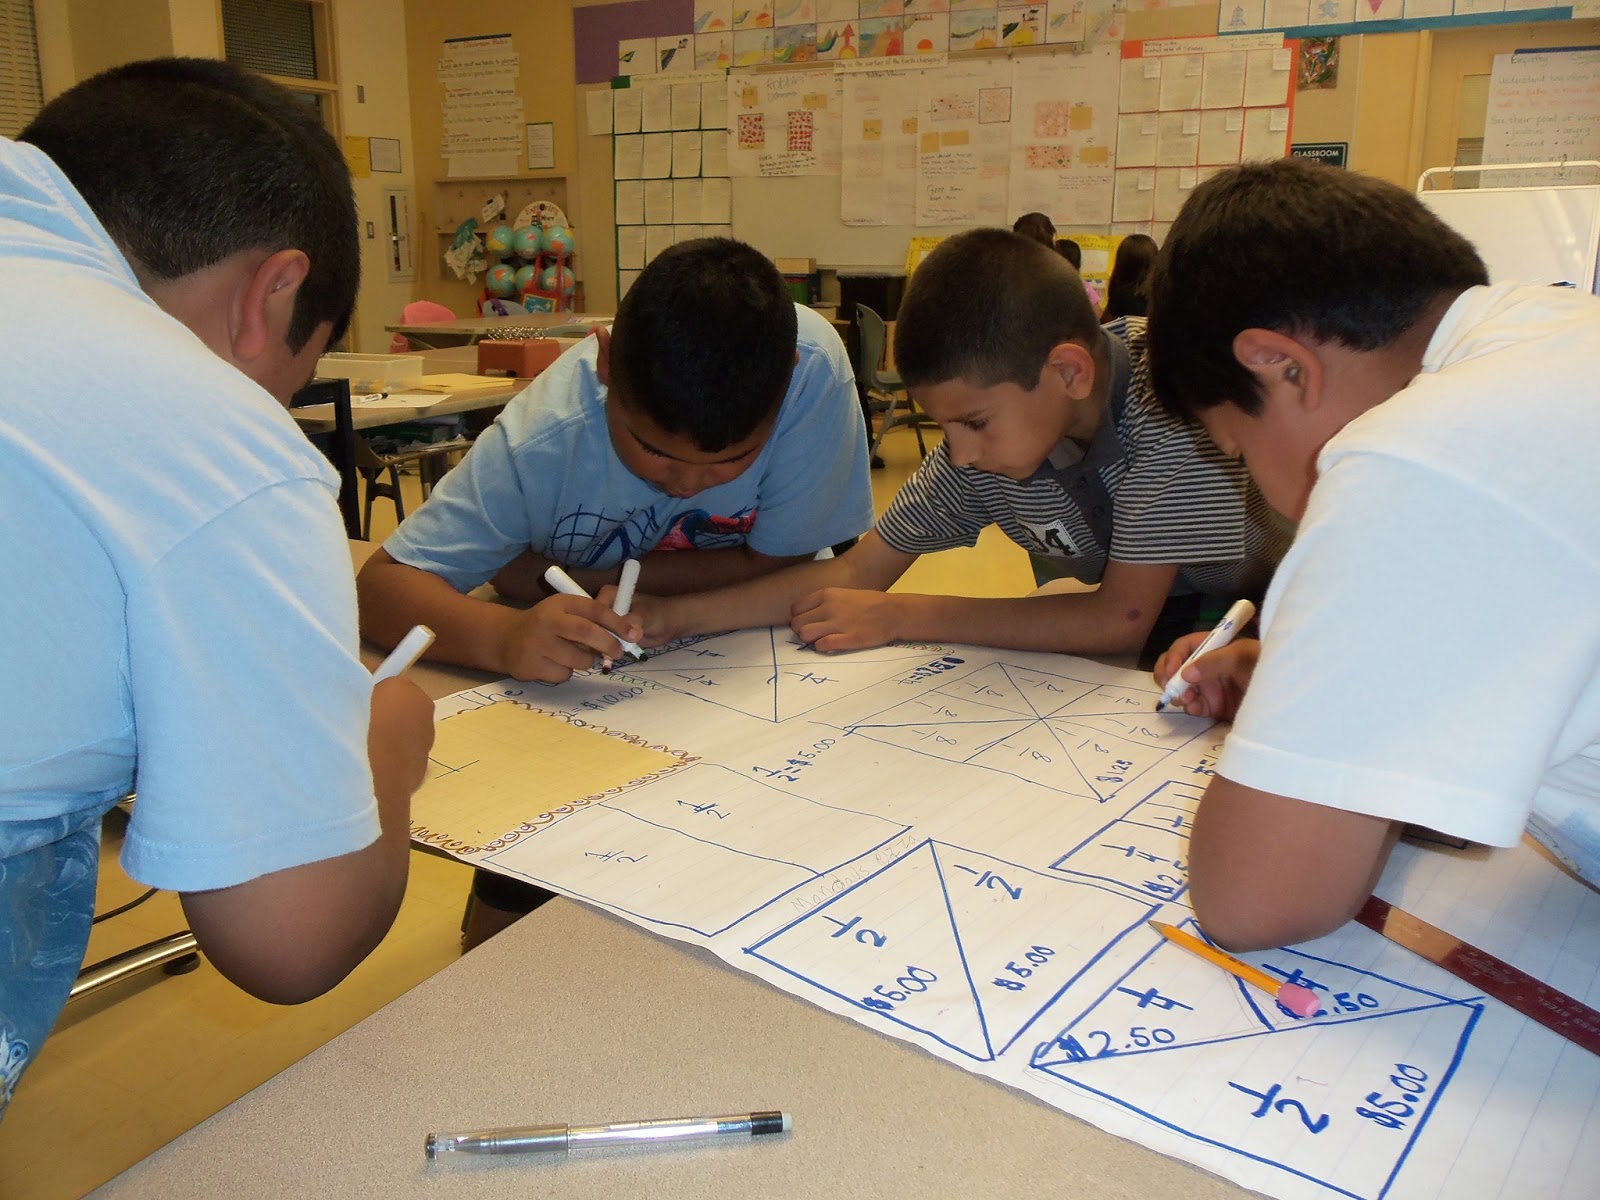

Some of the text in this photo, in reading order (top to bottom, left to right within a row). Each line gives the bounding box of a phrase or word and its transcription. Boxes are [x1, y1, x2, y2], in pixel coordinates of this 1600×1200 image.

[1293, 149, 1339, 157] CLASSROOM
[457, 689, 524, 708] The
[860, 966, 939, 1011] $5.00
[991, 945, 1057, 991] $5.00
[1356, 1064, 1430, 1131] $5.00
